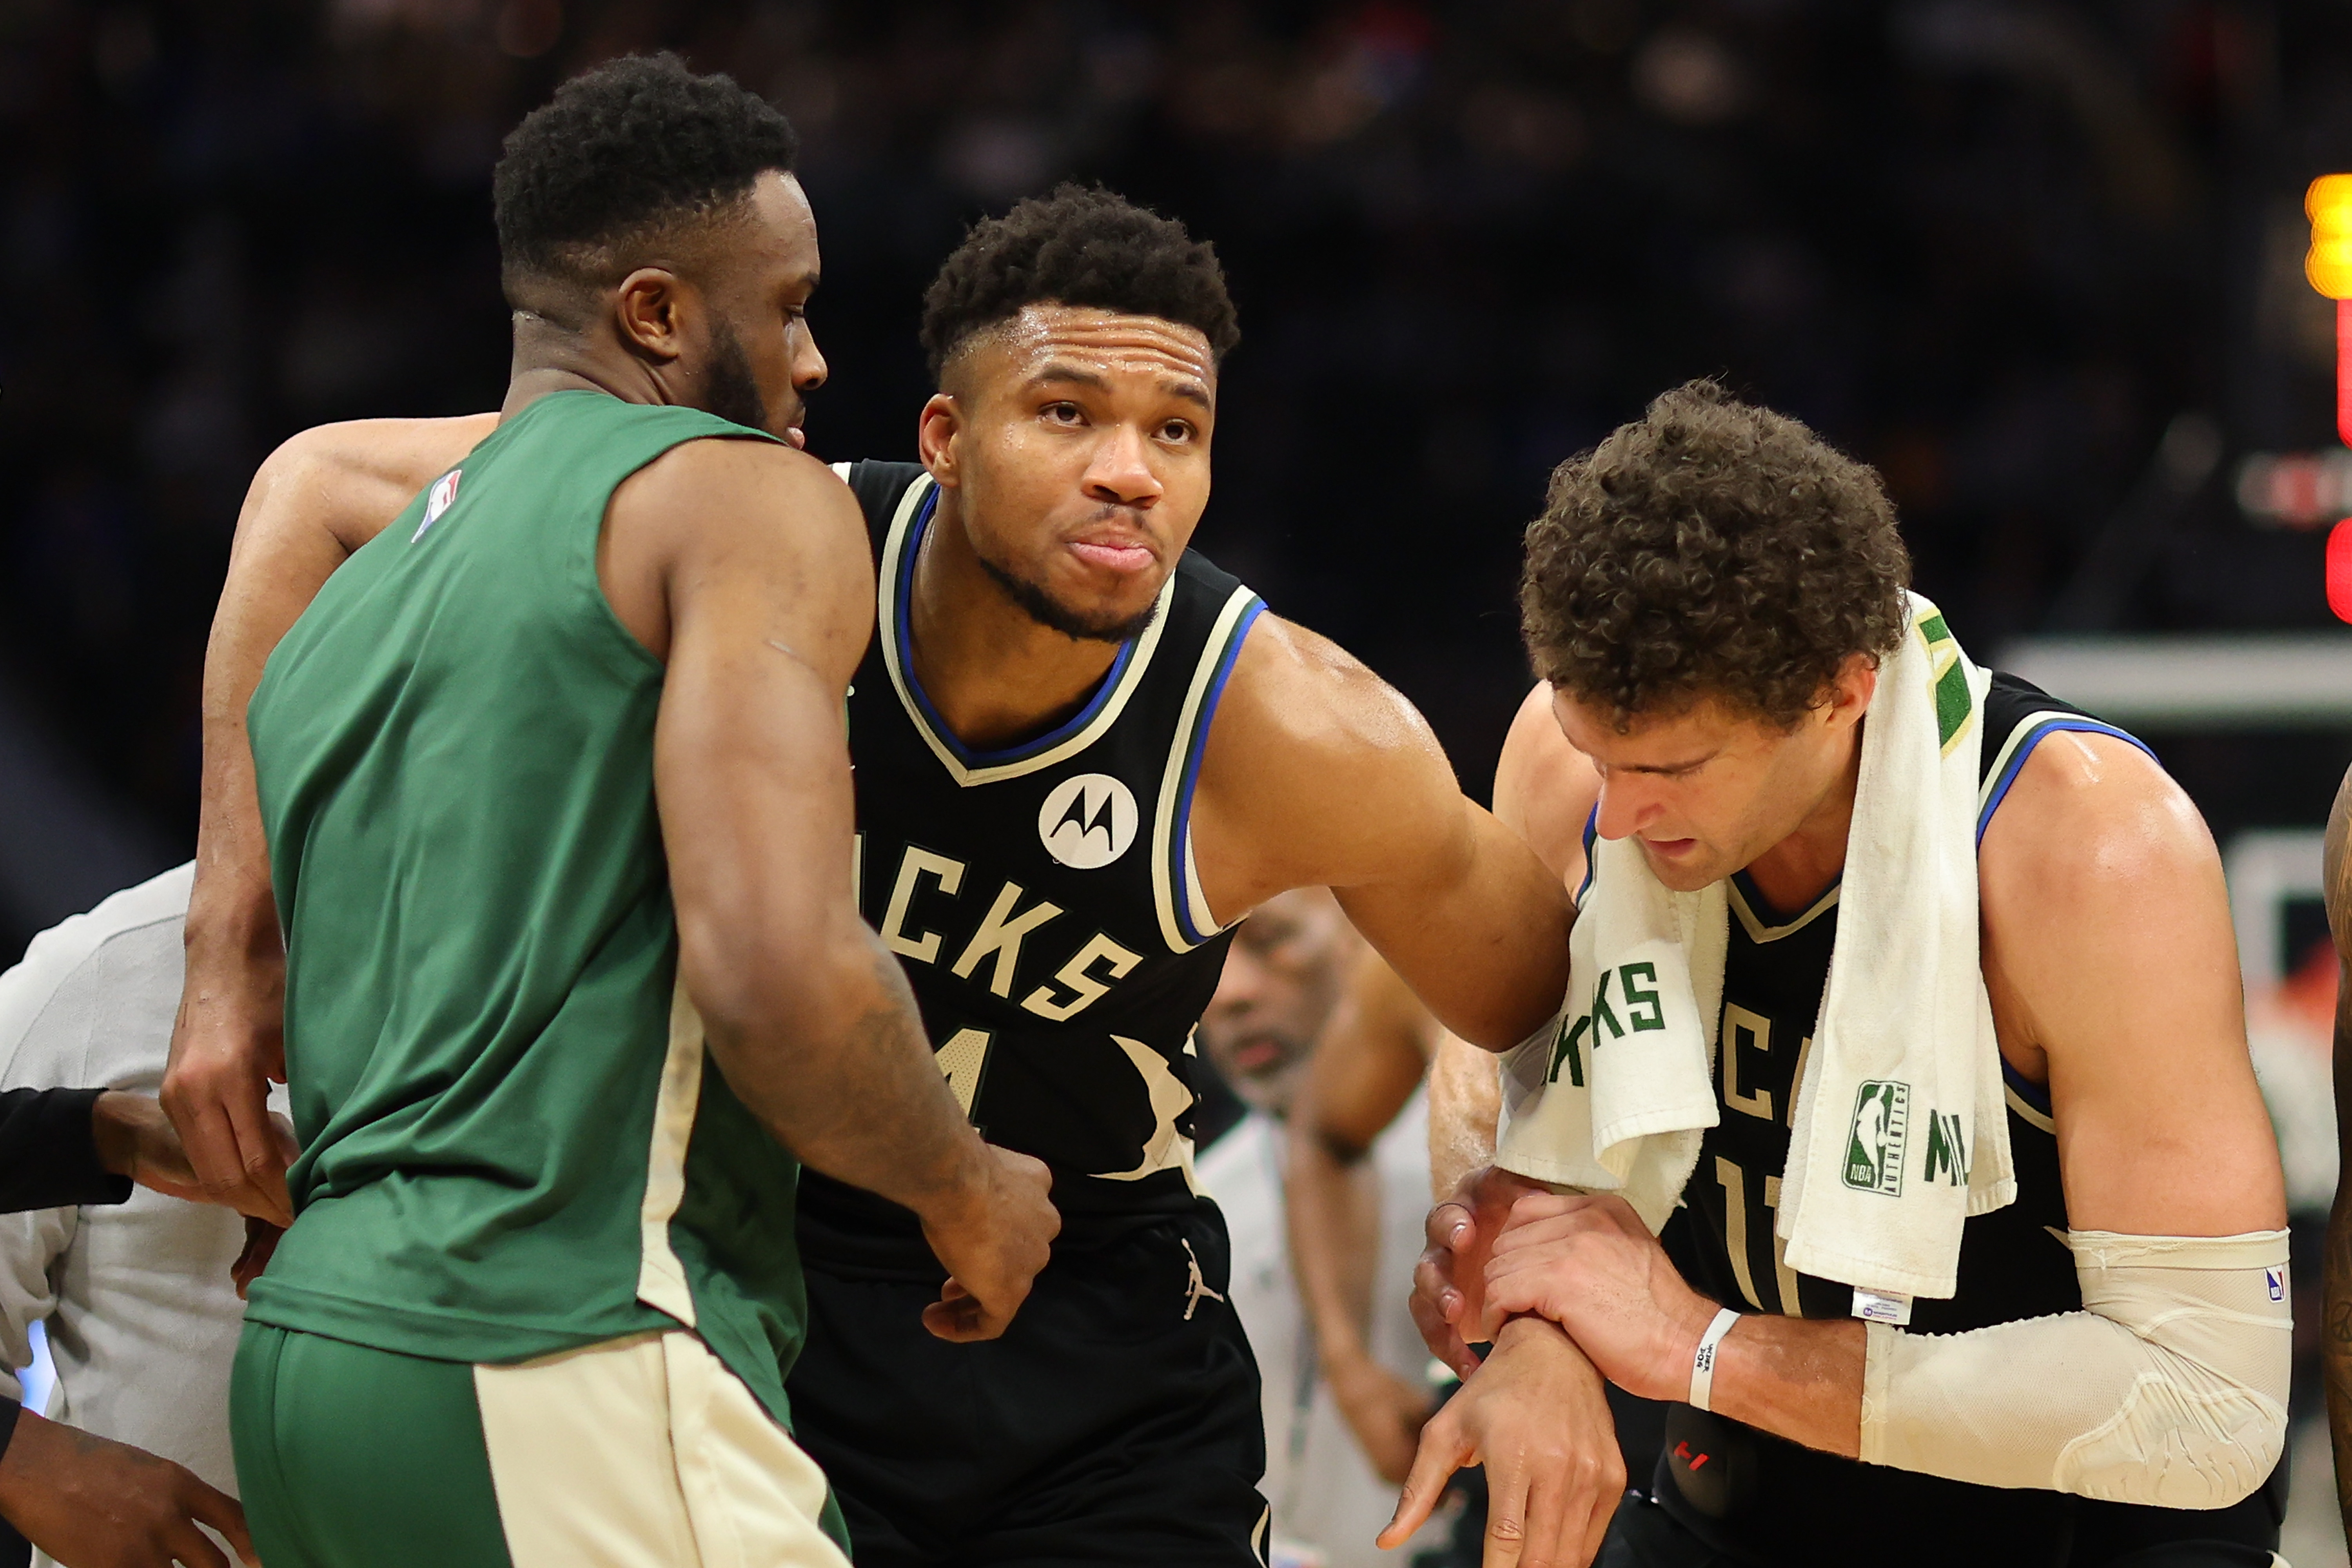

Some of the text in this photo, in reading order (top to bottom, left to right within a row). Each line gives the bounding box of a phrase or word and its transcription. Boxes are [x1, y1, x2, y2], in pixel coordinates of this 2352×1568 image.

[854, 834, 1144, 1022] CKS
[1850, 1163, 1872, 1183] NBA
[1884, 1086, 1906, 1192] AUTHENTICS
